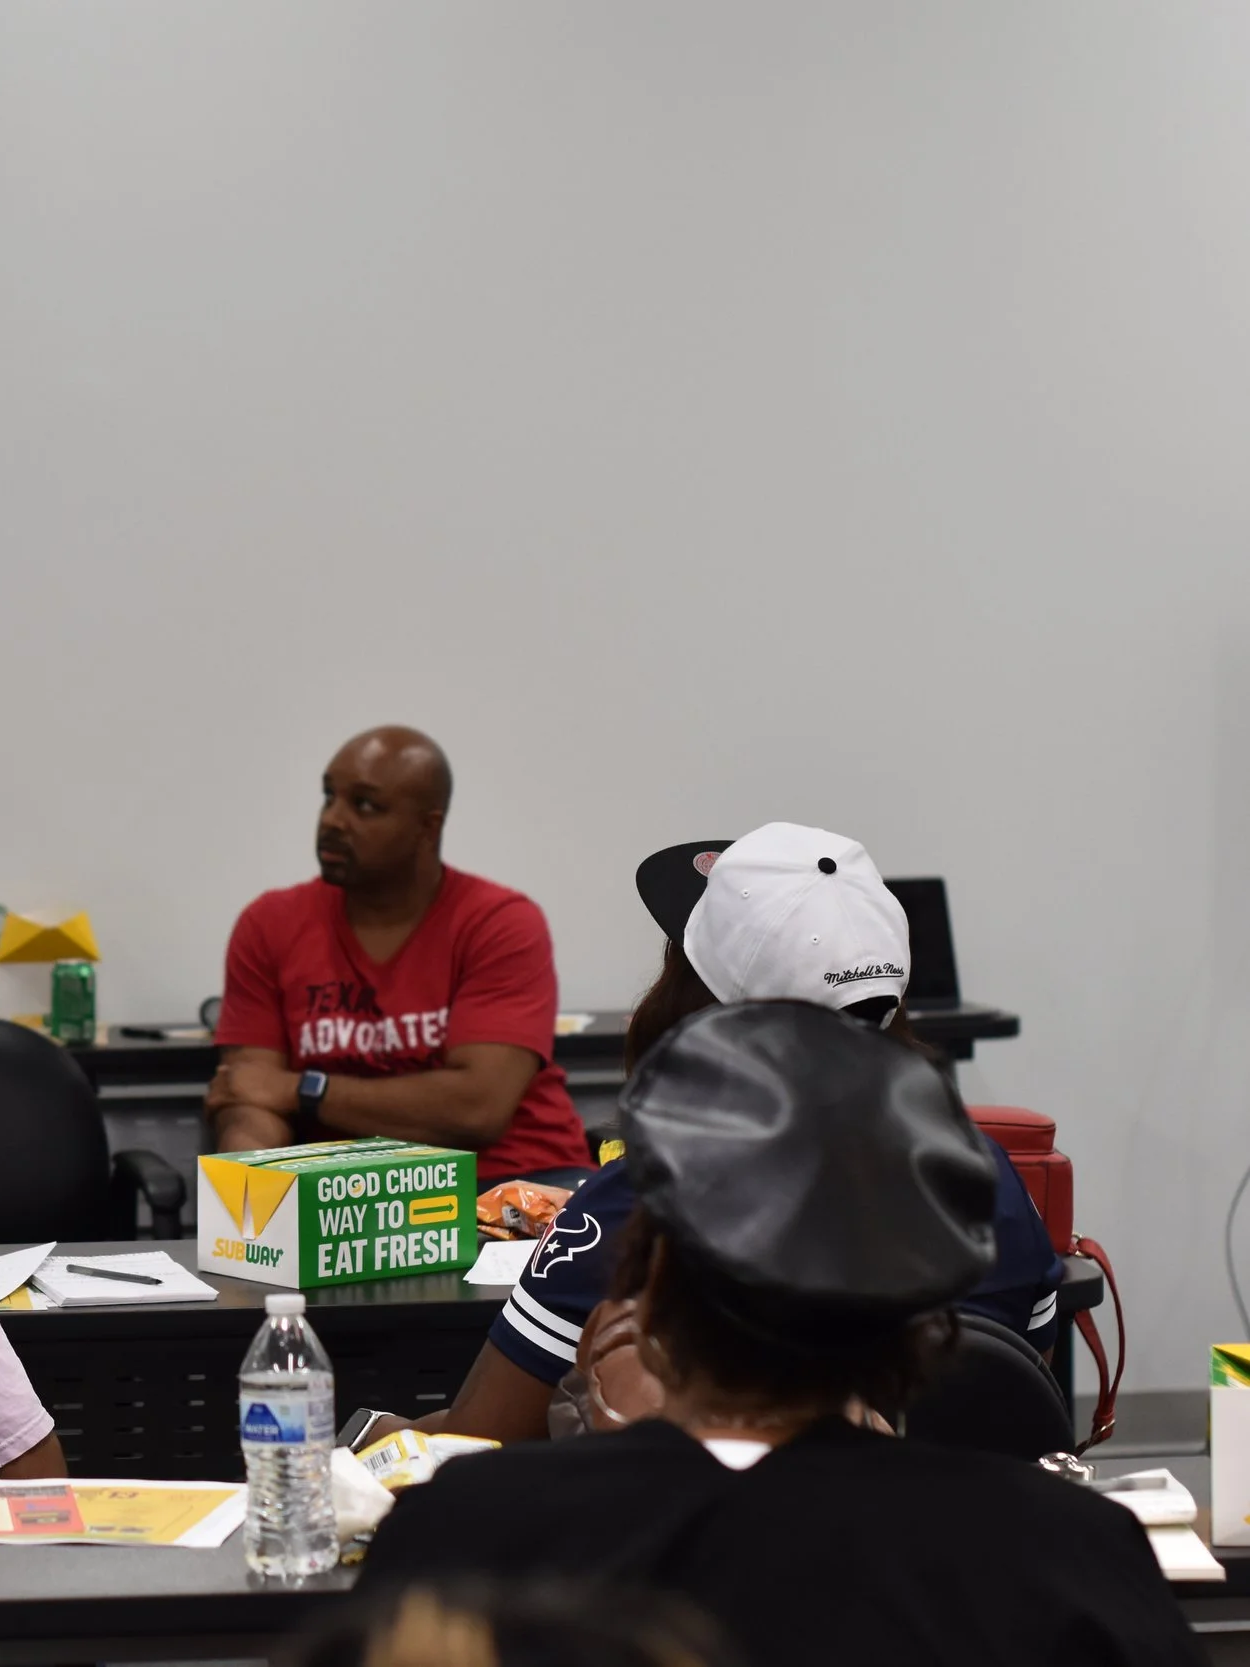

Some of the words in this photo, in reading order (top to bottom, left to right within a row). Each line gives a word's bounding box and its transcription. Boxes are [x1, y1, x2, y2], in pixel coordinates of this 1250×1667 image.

[824, 966, 874, 984] Mitchell
[875, 965, 883, 975] &
[883, 963, 904, 975] Ness
[317, 1172, 381, 1203] GOOD
[386, 1163, 458, 1195] CHOICE
[318, 1204, 368, 1238] WAY
[374, 1200, 405, 1230] TO
[211, 1238, 284, 1267] SUBWAY
[317, 1238, 368, 1278] EAT
[374, 1228, 458, 1271] FRESH
